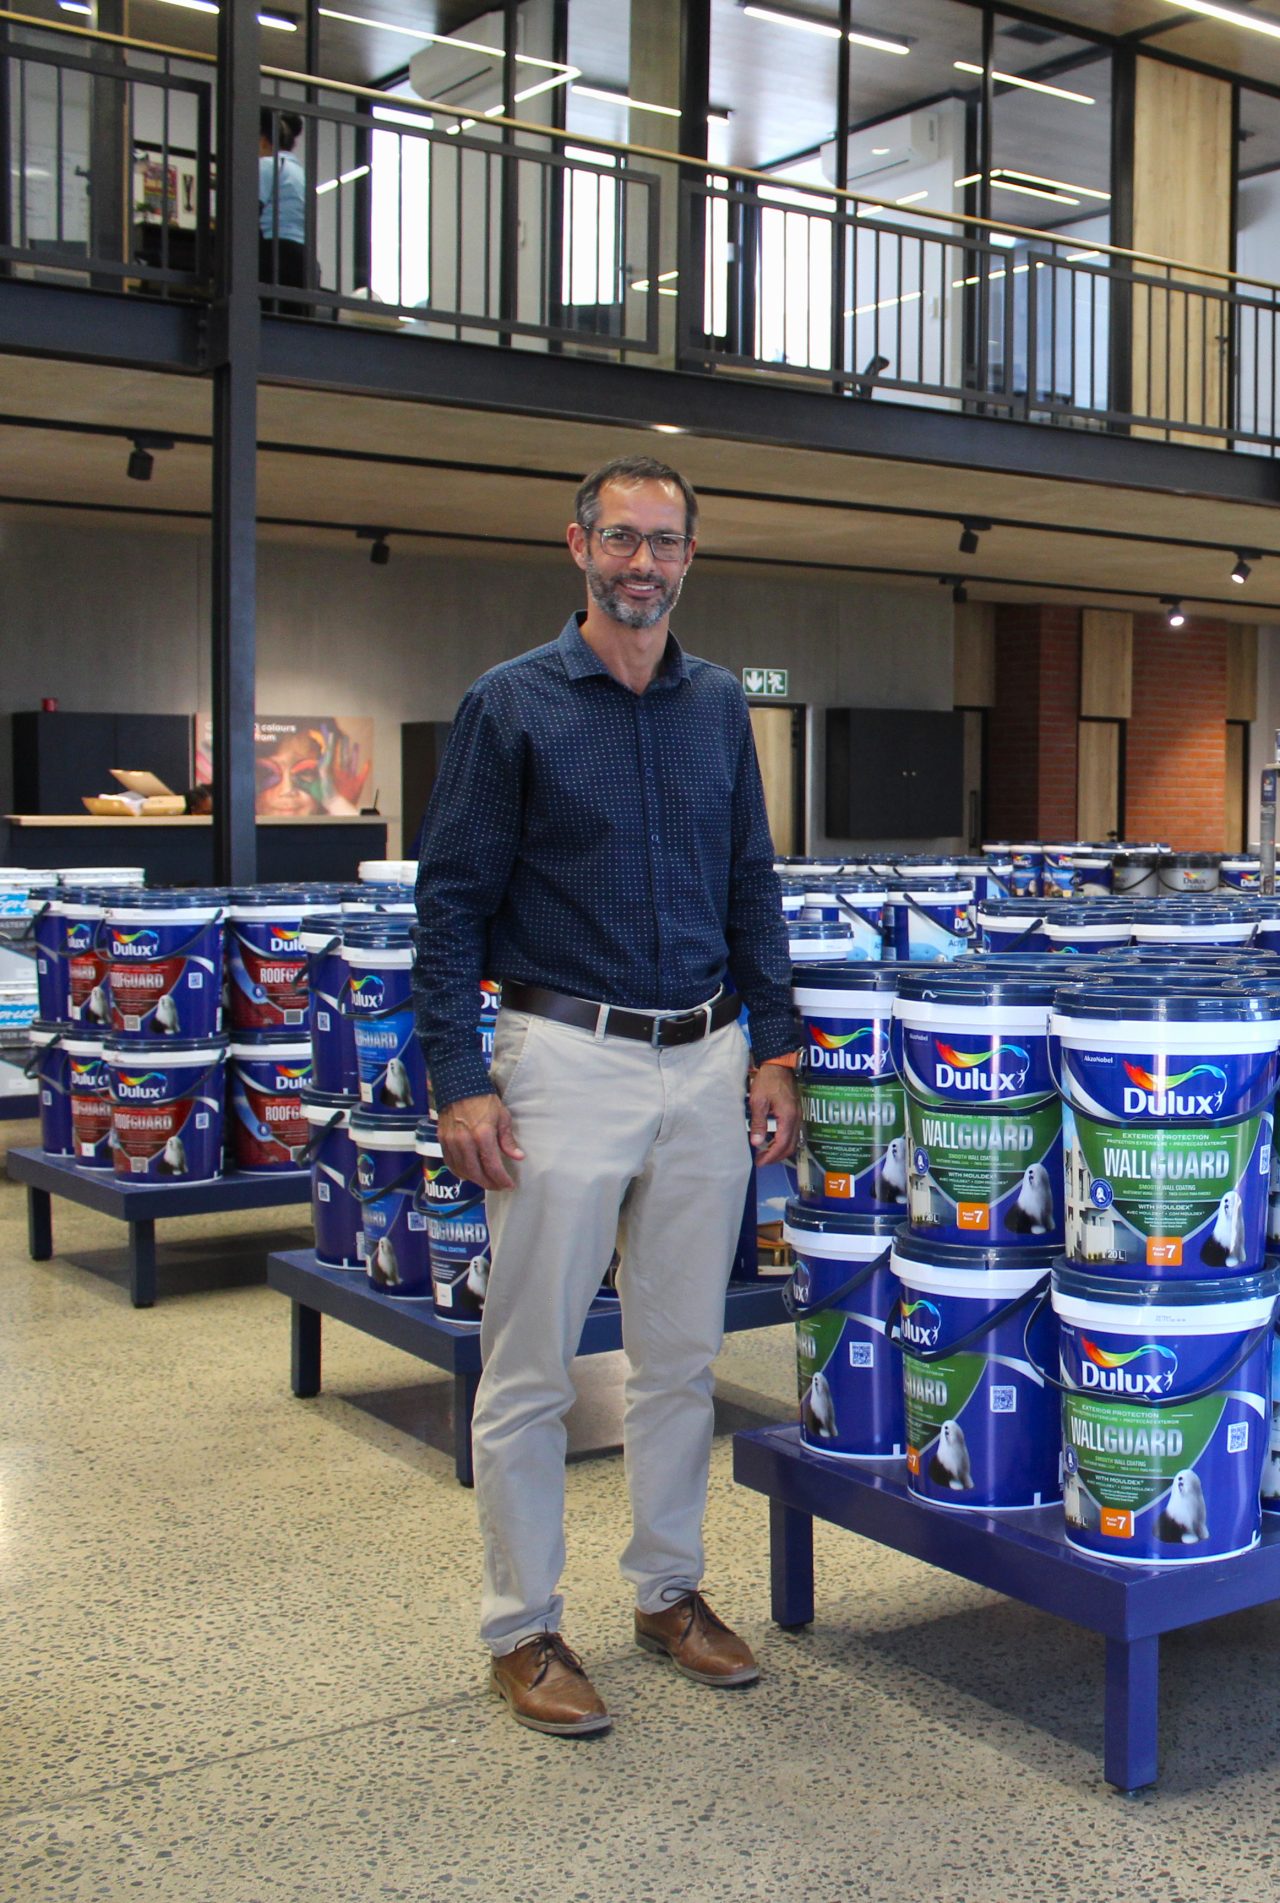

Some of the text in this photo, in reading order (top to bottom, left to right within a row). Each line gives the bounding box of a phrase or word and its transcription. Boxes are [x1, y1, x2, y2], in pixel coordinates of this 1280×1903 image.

[261, 723, 297, 733] colours
[113, 943, 152, 955] Dulux
[809, 1045, 878, 1071] Dulux
[1084, 1055, 1114, 1064] AkzoNobel
[935, 1063, 1016, 1091] Dulux
[118, 1084, 160, 1098] Dulux
[1123, 1087, 1214, 1116] Dulux
[922, 1118, 1034, 1151] WALLGUARD
[1103, 1147, 1230, 1180] WALLGUARD
[838, 1179, 847, 1191] 7
[974, 1210, 984, 1223] 7
[1107, 1250, 1118, 1260] 20
[1165, 1244, 1176, 1259] 7
[1081, 1361, 1163, 1394] Dulux
[1082, 1404, 1160, 1419] EXTERIOR PROTECTION
[1070, 1415, 1184, 1457] WALLGUARD
[1117, 1516, 1127, 1530] 7
